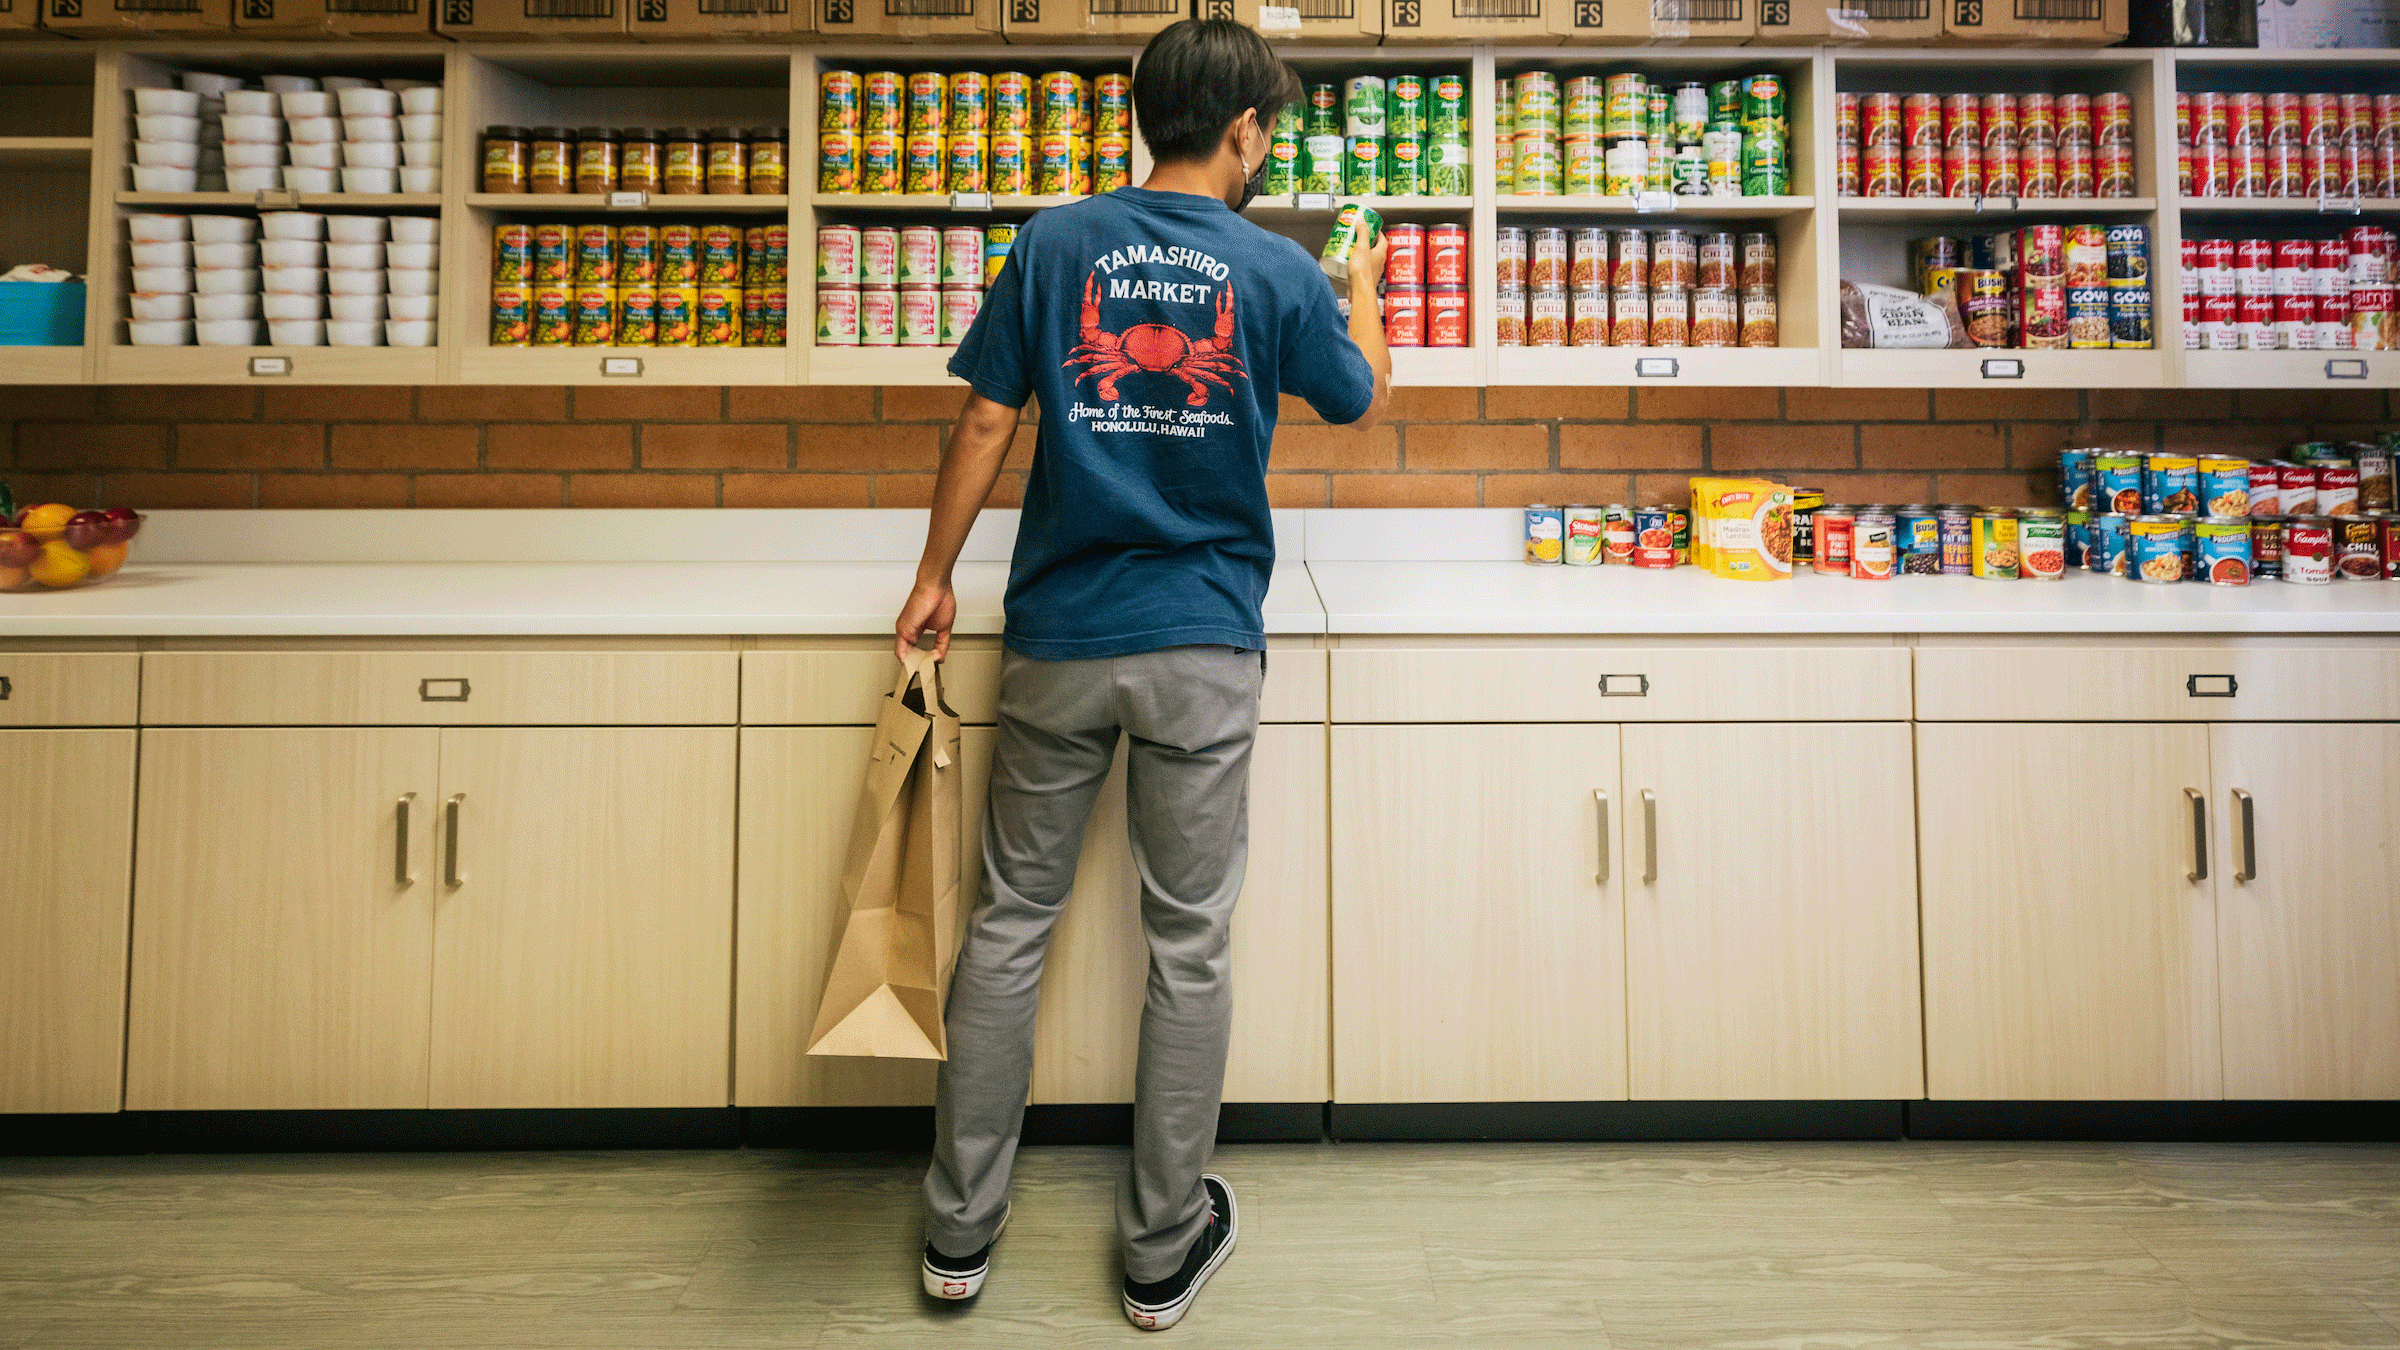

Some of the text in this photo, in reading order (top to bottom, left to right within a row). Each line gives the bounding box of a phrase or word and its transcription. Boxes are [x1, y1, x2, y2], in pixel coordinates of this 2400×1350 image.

[446, 0, 470, 21] FS
[639, 0, 665, 19] FS
[826, 0, 851, 20] FS
[1013, 0, 1038, 19] FS
[1208, 1, 1233, 20] FS
[1394, 2, 1419, 24] FS
[1577, 3, 1601, 25] FS
[1763, 3, 1788, 23] FS
[1957, 2, 1981, 23] FS
[2107, 229, 2143, 242] OYA
[1095, 244, 1230, 282] TAMASHIRO
[1109, 278, 1211, 304] MARKET
[2072, 290, 2109, 304] GOYA
[2113, 290, 2150, 305] GOYA
[1069, 402, 1105, 422] Home
[1108, 402, 1121, 420] of
[1122, 404, 1142, 418] the
[1142, 405, 1177, 422] Finest
[1161, 422, 1206, 437] HAWAII
